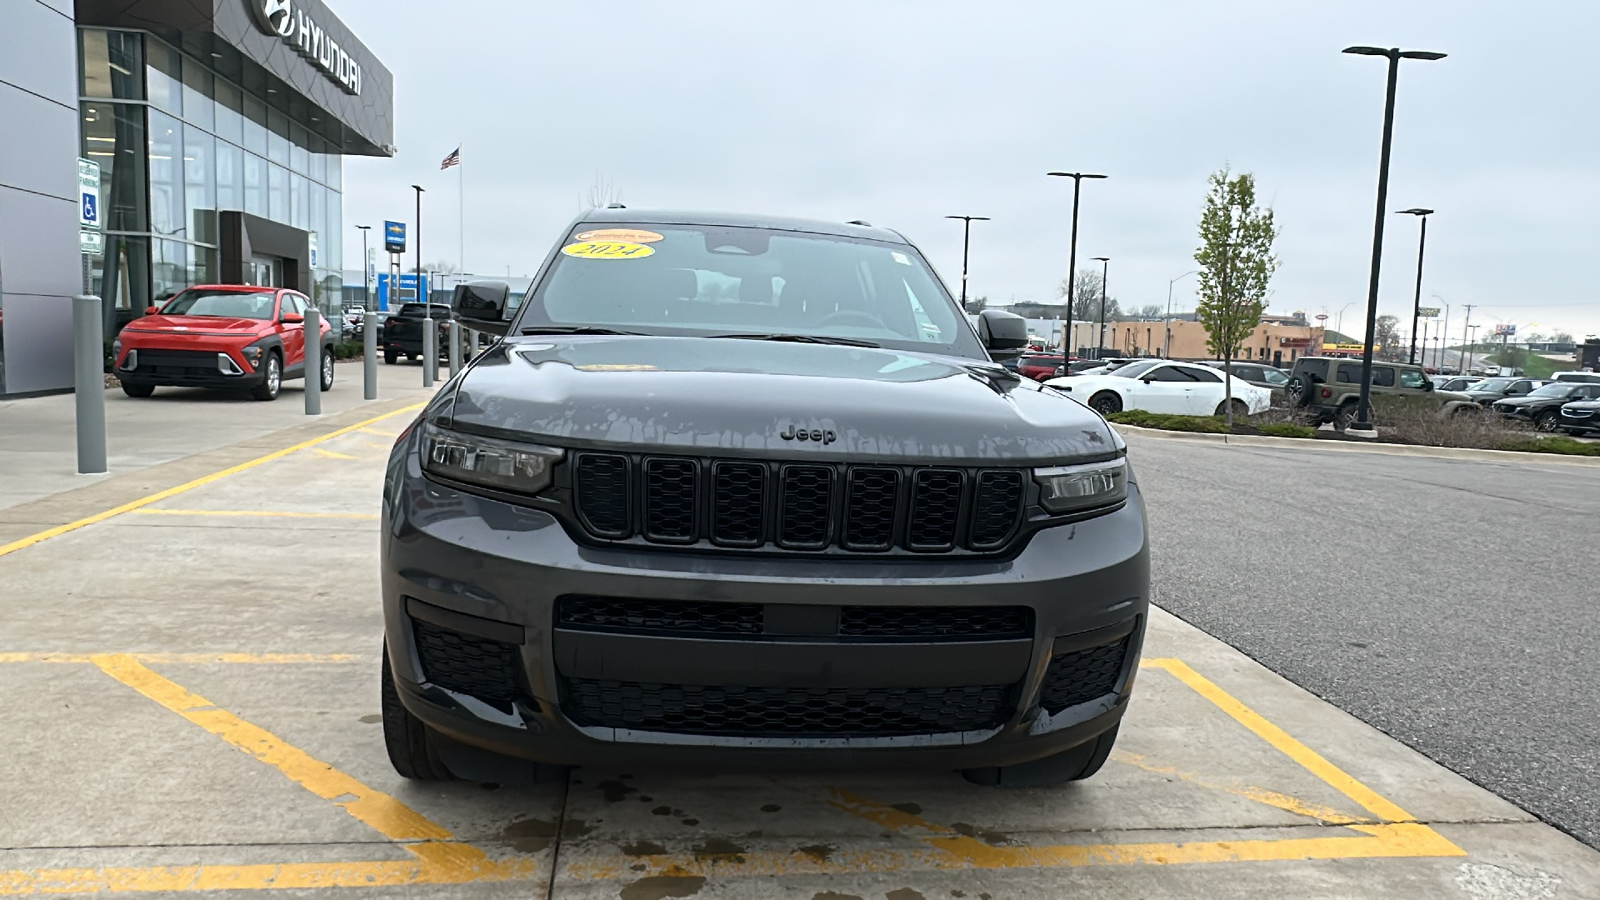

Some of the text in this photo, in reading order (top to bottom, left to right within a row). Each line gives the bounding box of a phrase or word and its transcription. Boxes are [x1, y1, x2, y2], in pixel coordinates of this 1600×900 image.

[298, 9, 361, 96] HYUNDAI
[572, 244, 644, 256] 2024
[780, 425, 836, 445] Jeep
